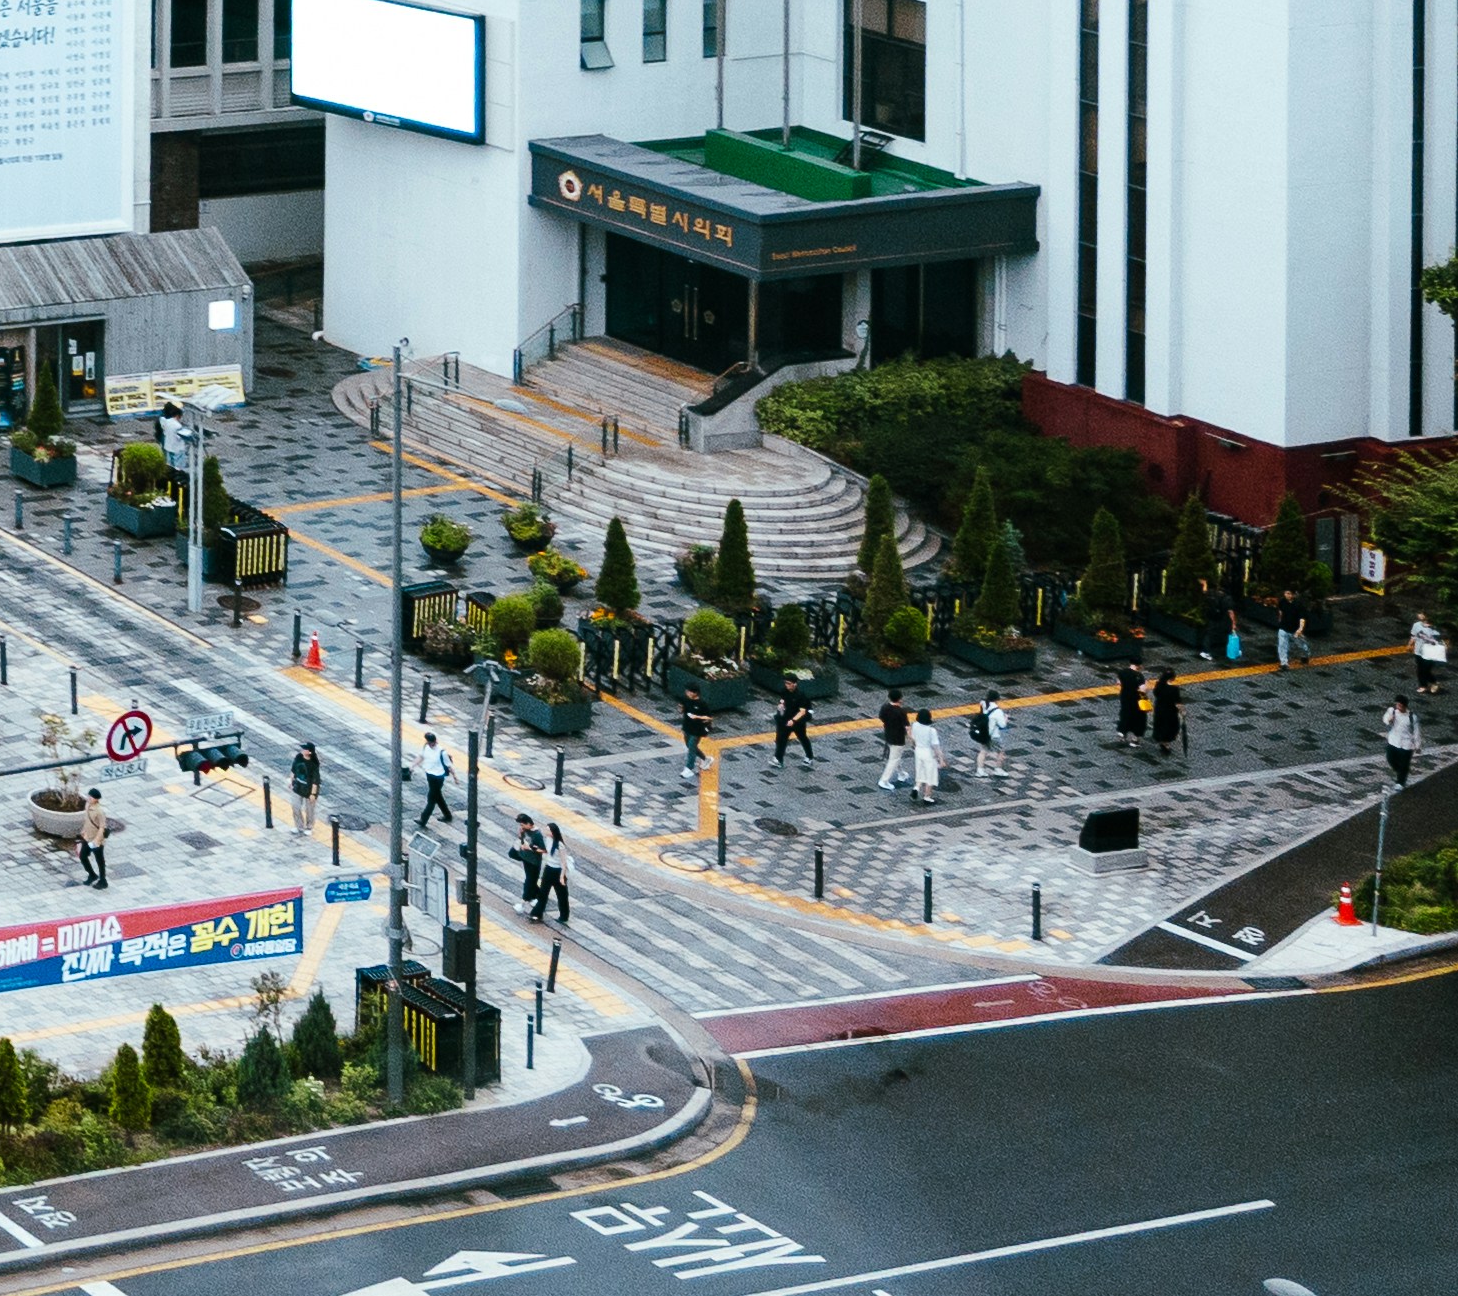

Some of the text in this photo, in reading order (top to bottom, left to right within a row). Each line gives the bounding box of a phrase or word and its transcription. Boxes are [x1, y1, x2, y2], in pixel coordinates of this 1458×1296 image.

[587, 184, 733, 248] 서울특별시의회
[41, 936, 56, 954] =
[58, 915, 123, 954] 미끼쇼
[62, 901, 295, 983] 진짜 목적은 꼼수 개헌
[243, 938, 298, 957] 자유통일당
